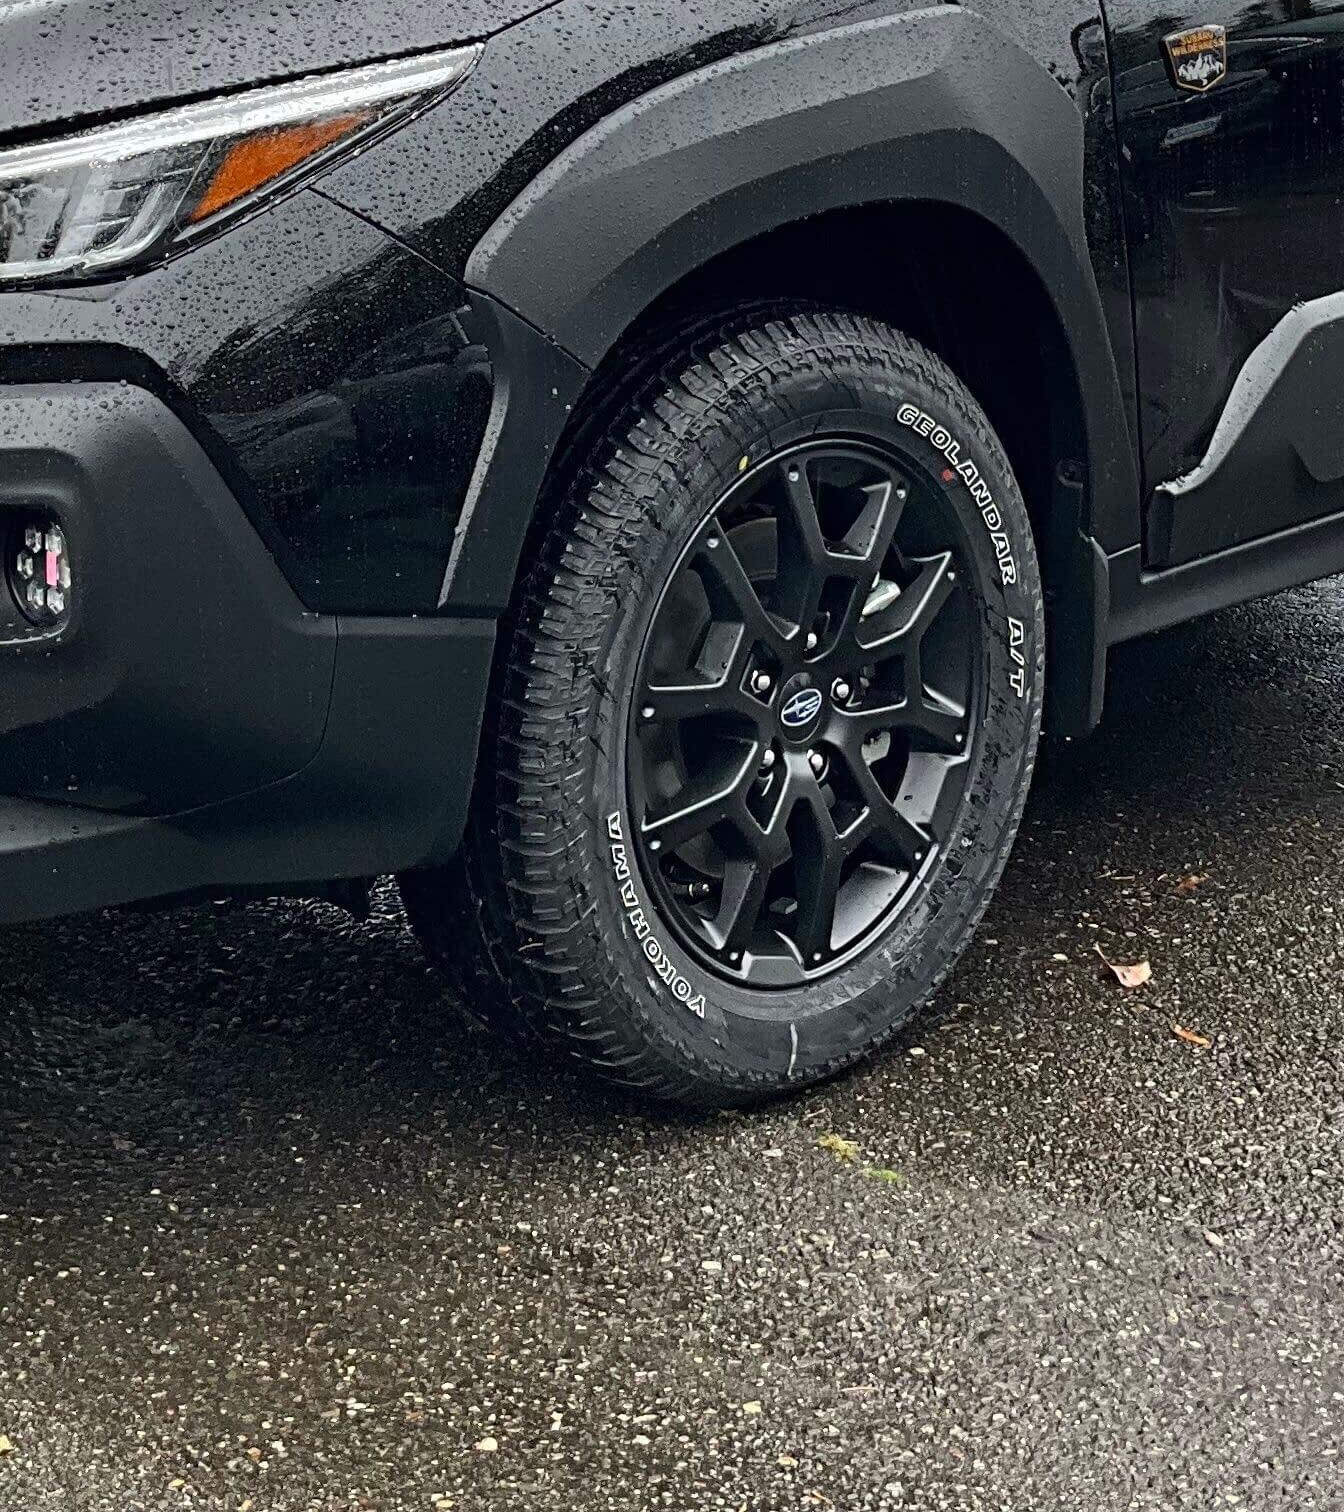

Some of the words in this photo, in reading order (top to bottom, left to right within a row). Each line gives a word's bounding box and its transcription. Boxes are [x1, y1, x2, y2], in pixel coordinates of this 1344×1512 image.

[897, 403, 1017, 586] GEOLANDAR
[1007, 616, 1025, 697] A/T
[608, 810, 706, 1019] YOKOHAMA
